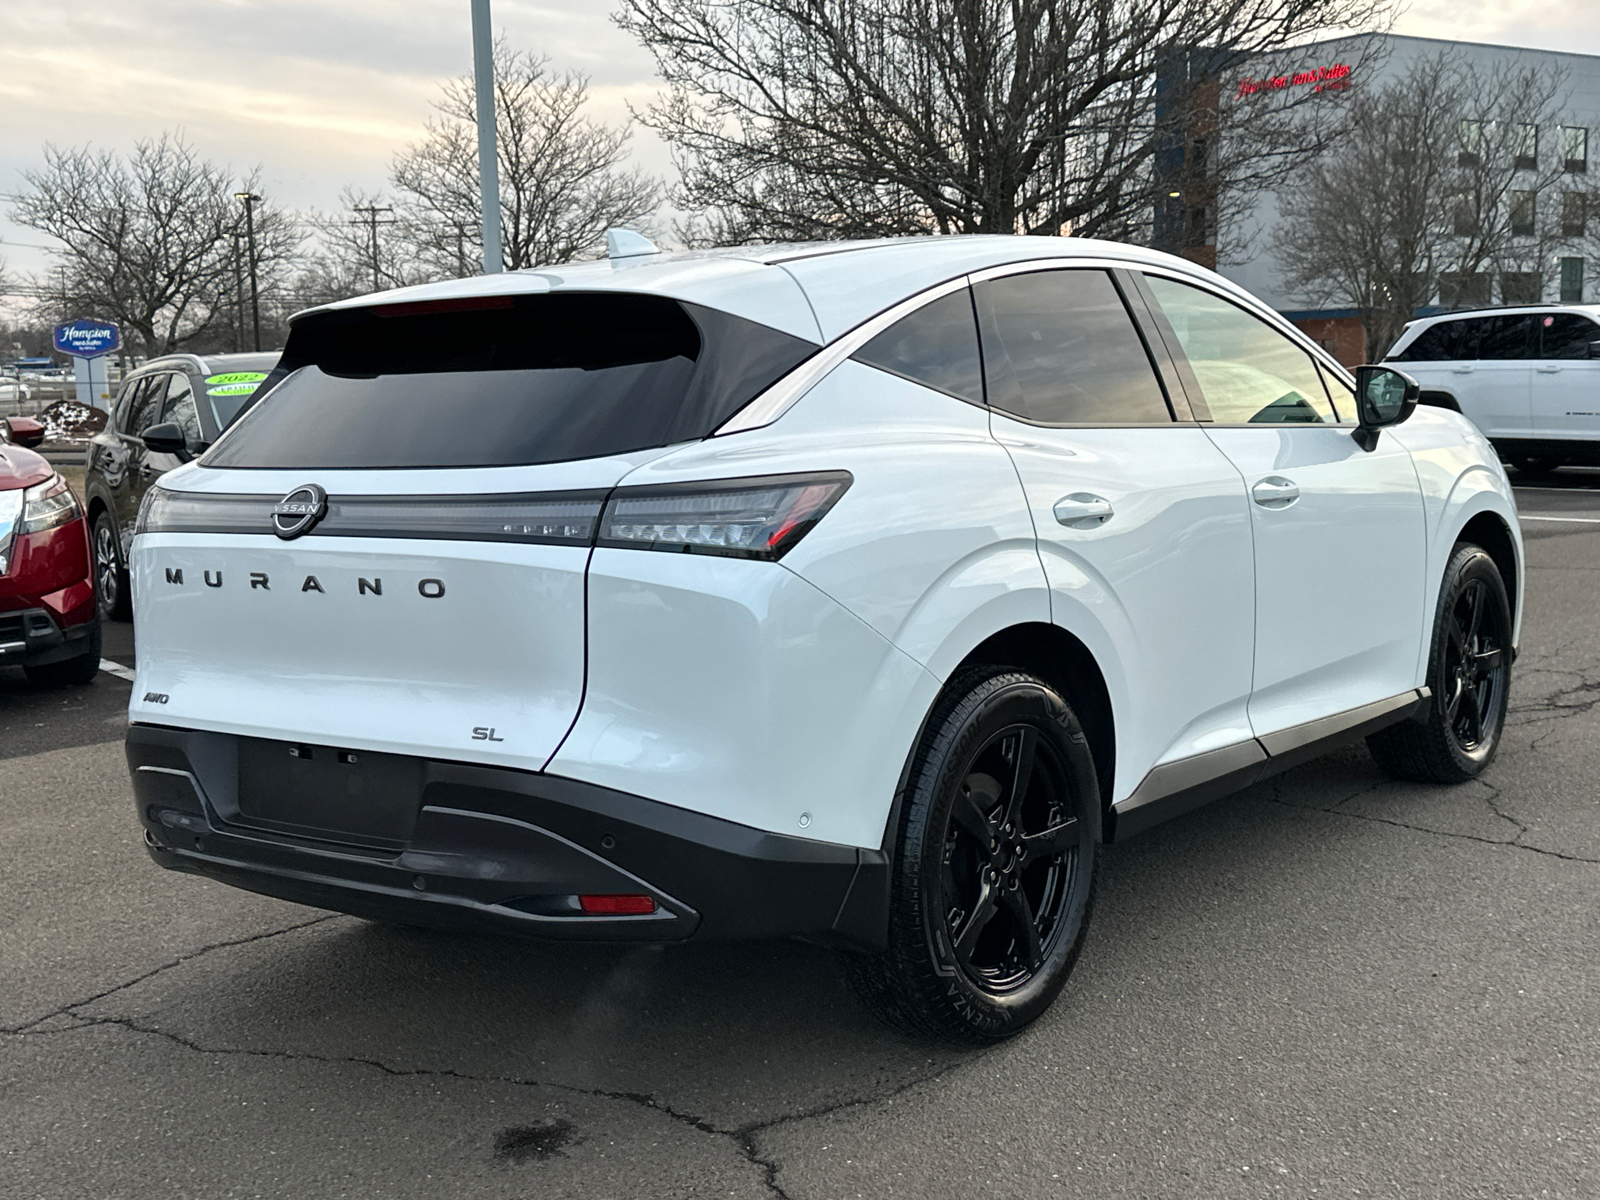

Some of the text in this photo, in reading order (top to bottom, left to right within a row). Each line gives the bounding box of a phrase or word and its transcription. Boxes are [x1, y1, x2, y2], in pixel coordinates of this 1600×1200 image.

[59, 325, 111, 342] Hampton
[217, 374, 259, 384] 2022
[274, 504, 318, 513] NISSAN
[164, 567, 447, 598] MURANO
[471, 726, 504, 742] SL
